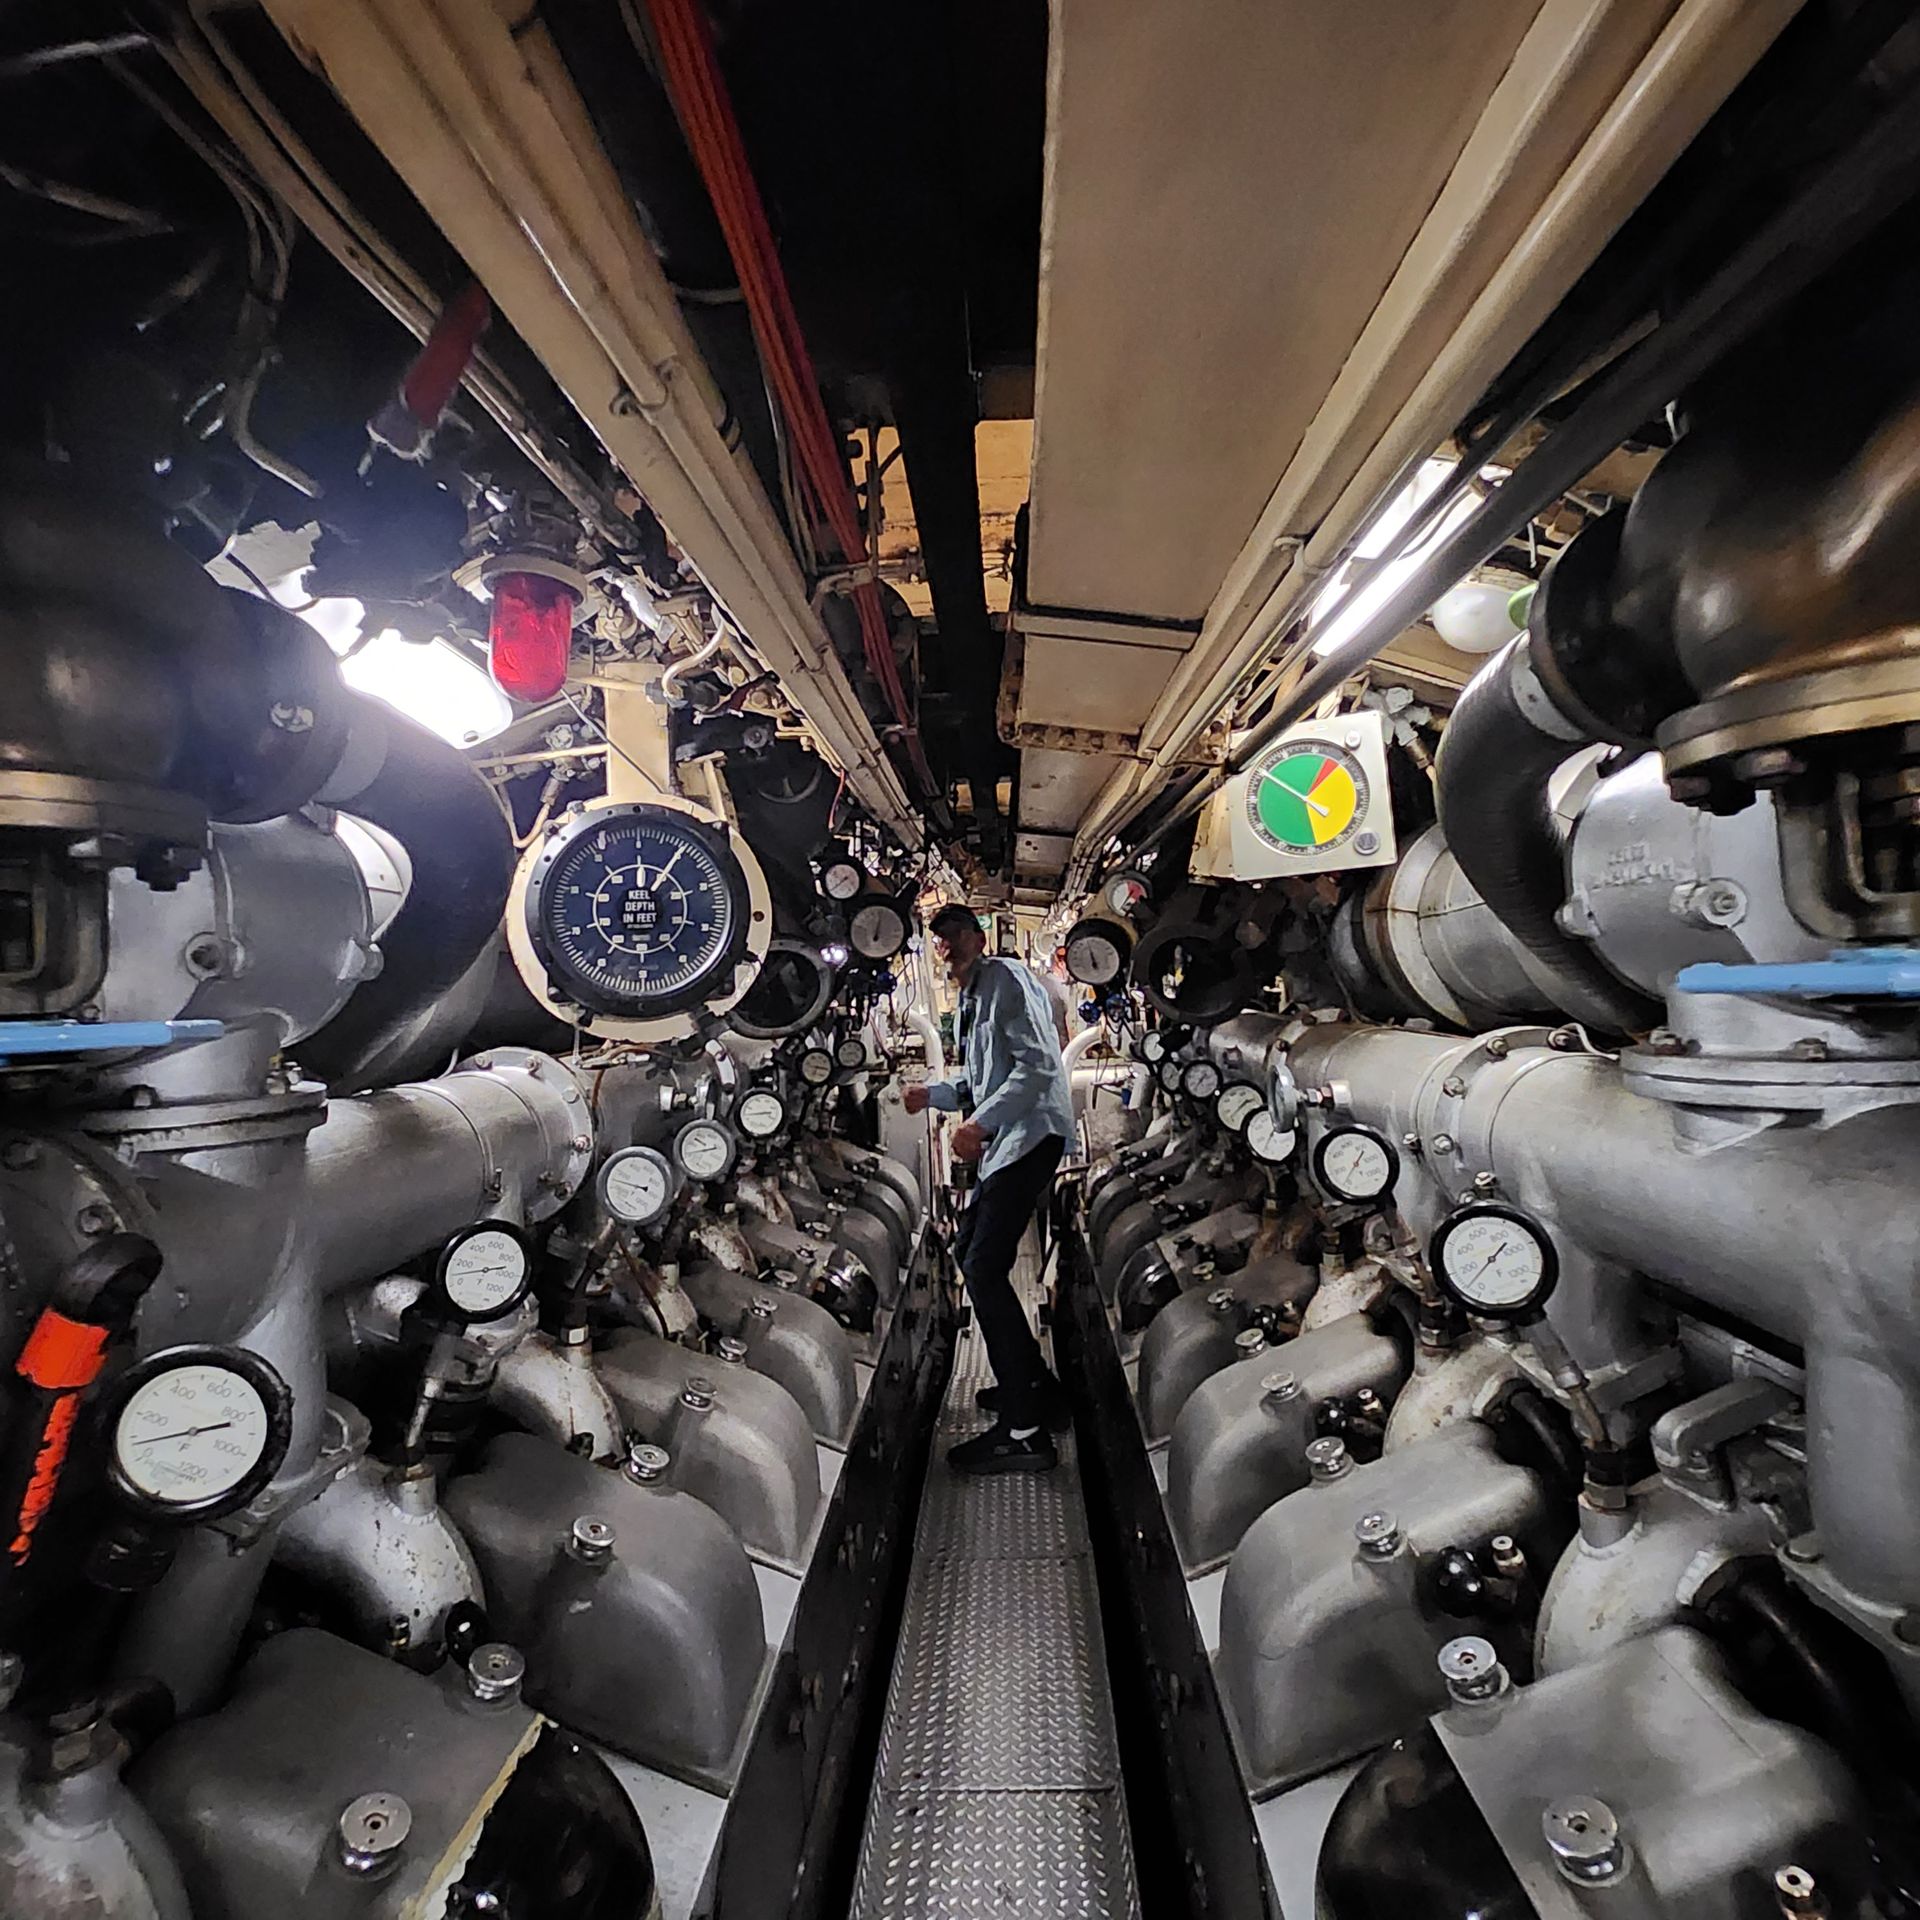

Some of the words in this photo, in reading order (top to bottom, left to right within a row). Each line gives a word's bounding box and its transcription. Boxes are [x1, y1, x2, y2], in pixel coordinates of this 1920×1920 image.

[628, 890, 650, 900] KEEL
[625, 902, 655, 911] DEPTH
[623, 913, 634, 923] IN
[636, 912, 657, 923] FEET
[456, 1259, 474, 1269] 200
[486, 1283, 505, 1293] 1200
[169, 1384, 196, 1400] 400
[206, 1382, 232, 1398] 600
[142, 1410, 169, 1427] 200
[221, 1406, 248, 1422] 800
[213, 1439, 241, 1456] 1000
[179, 1461, 208, 1479] 1200
